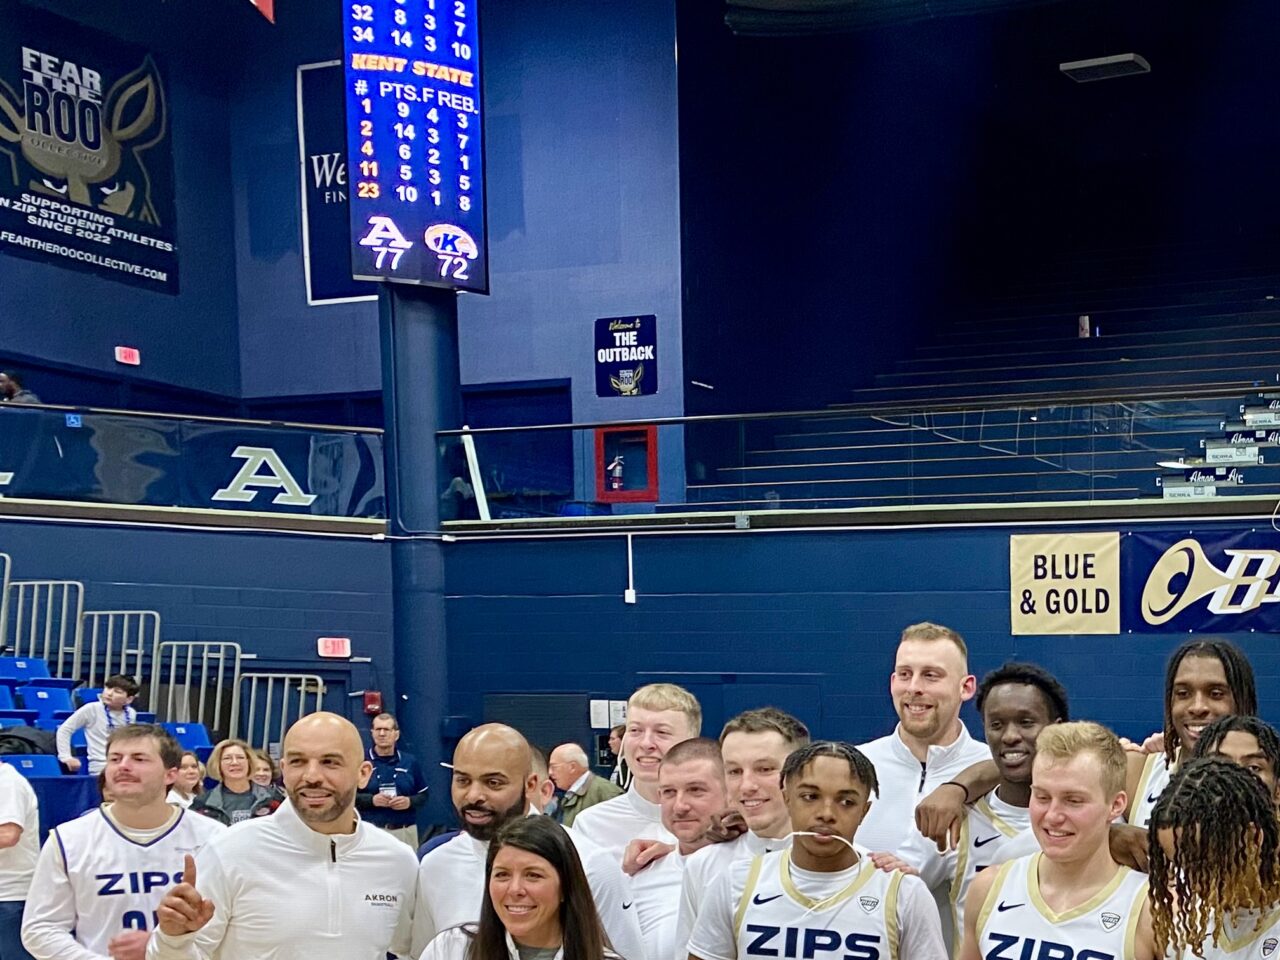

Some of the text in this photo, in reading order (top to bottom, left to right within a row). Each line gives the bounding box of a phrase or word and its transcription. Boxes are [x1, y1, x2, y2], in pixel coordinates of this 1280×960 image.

[352, 4, 465, 37] 32 8 3 7
[454, 1, 465, 17] 2
[352, 26, 471, 60] 34 14 3 10
[22, 46, 101, 93] FEAR
[352, 53, 473, 87] KENT STATE
[23, 68, 101, 105] THE
[355, 79, 479, 114] # PTS. F REB.
[23, 79, 101, 151] ROO
[362, 98, 468, 128] 1 9 4 3
[360, 120, 469, 149] 2 14 3 7
[361, 140, 468, 170] 4 6 2 1
[360, 161, 470, 190] 11 5 3 5
[21, 193, 114, 226] SUPPORTING
[358, 183, 470, 211] 23 10 1 8
[12, 201, 37, 214] ZIP
[40, 209, 104, 232] STUDENT
[107, 227, 173, 251] ATHLETES
[27, 215, 111, 245] SINCE 2022
[359, 216, 413, 248] A
[1, 231, 168, 282] FEARTHEROOCOLLECTIVE.COM
[372, 247, 468, 280] 77 72
[597, 345, 654, 363] OUTBACK
[613, 331, 637, 346] THE
[211, 446, 318, 506] A
[1034, 553, 1096, 580] BLUE
[1019, 588, 1110, 615] & GOLD
[365, 894, 397, 902] AKRON
